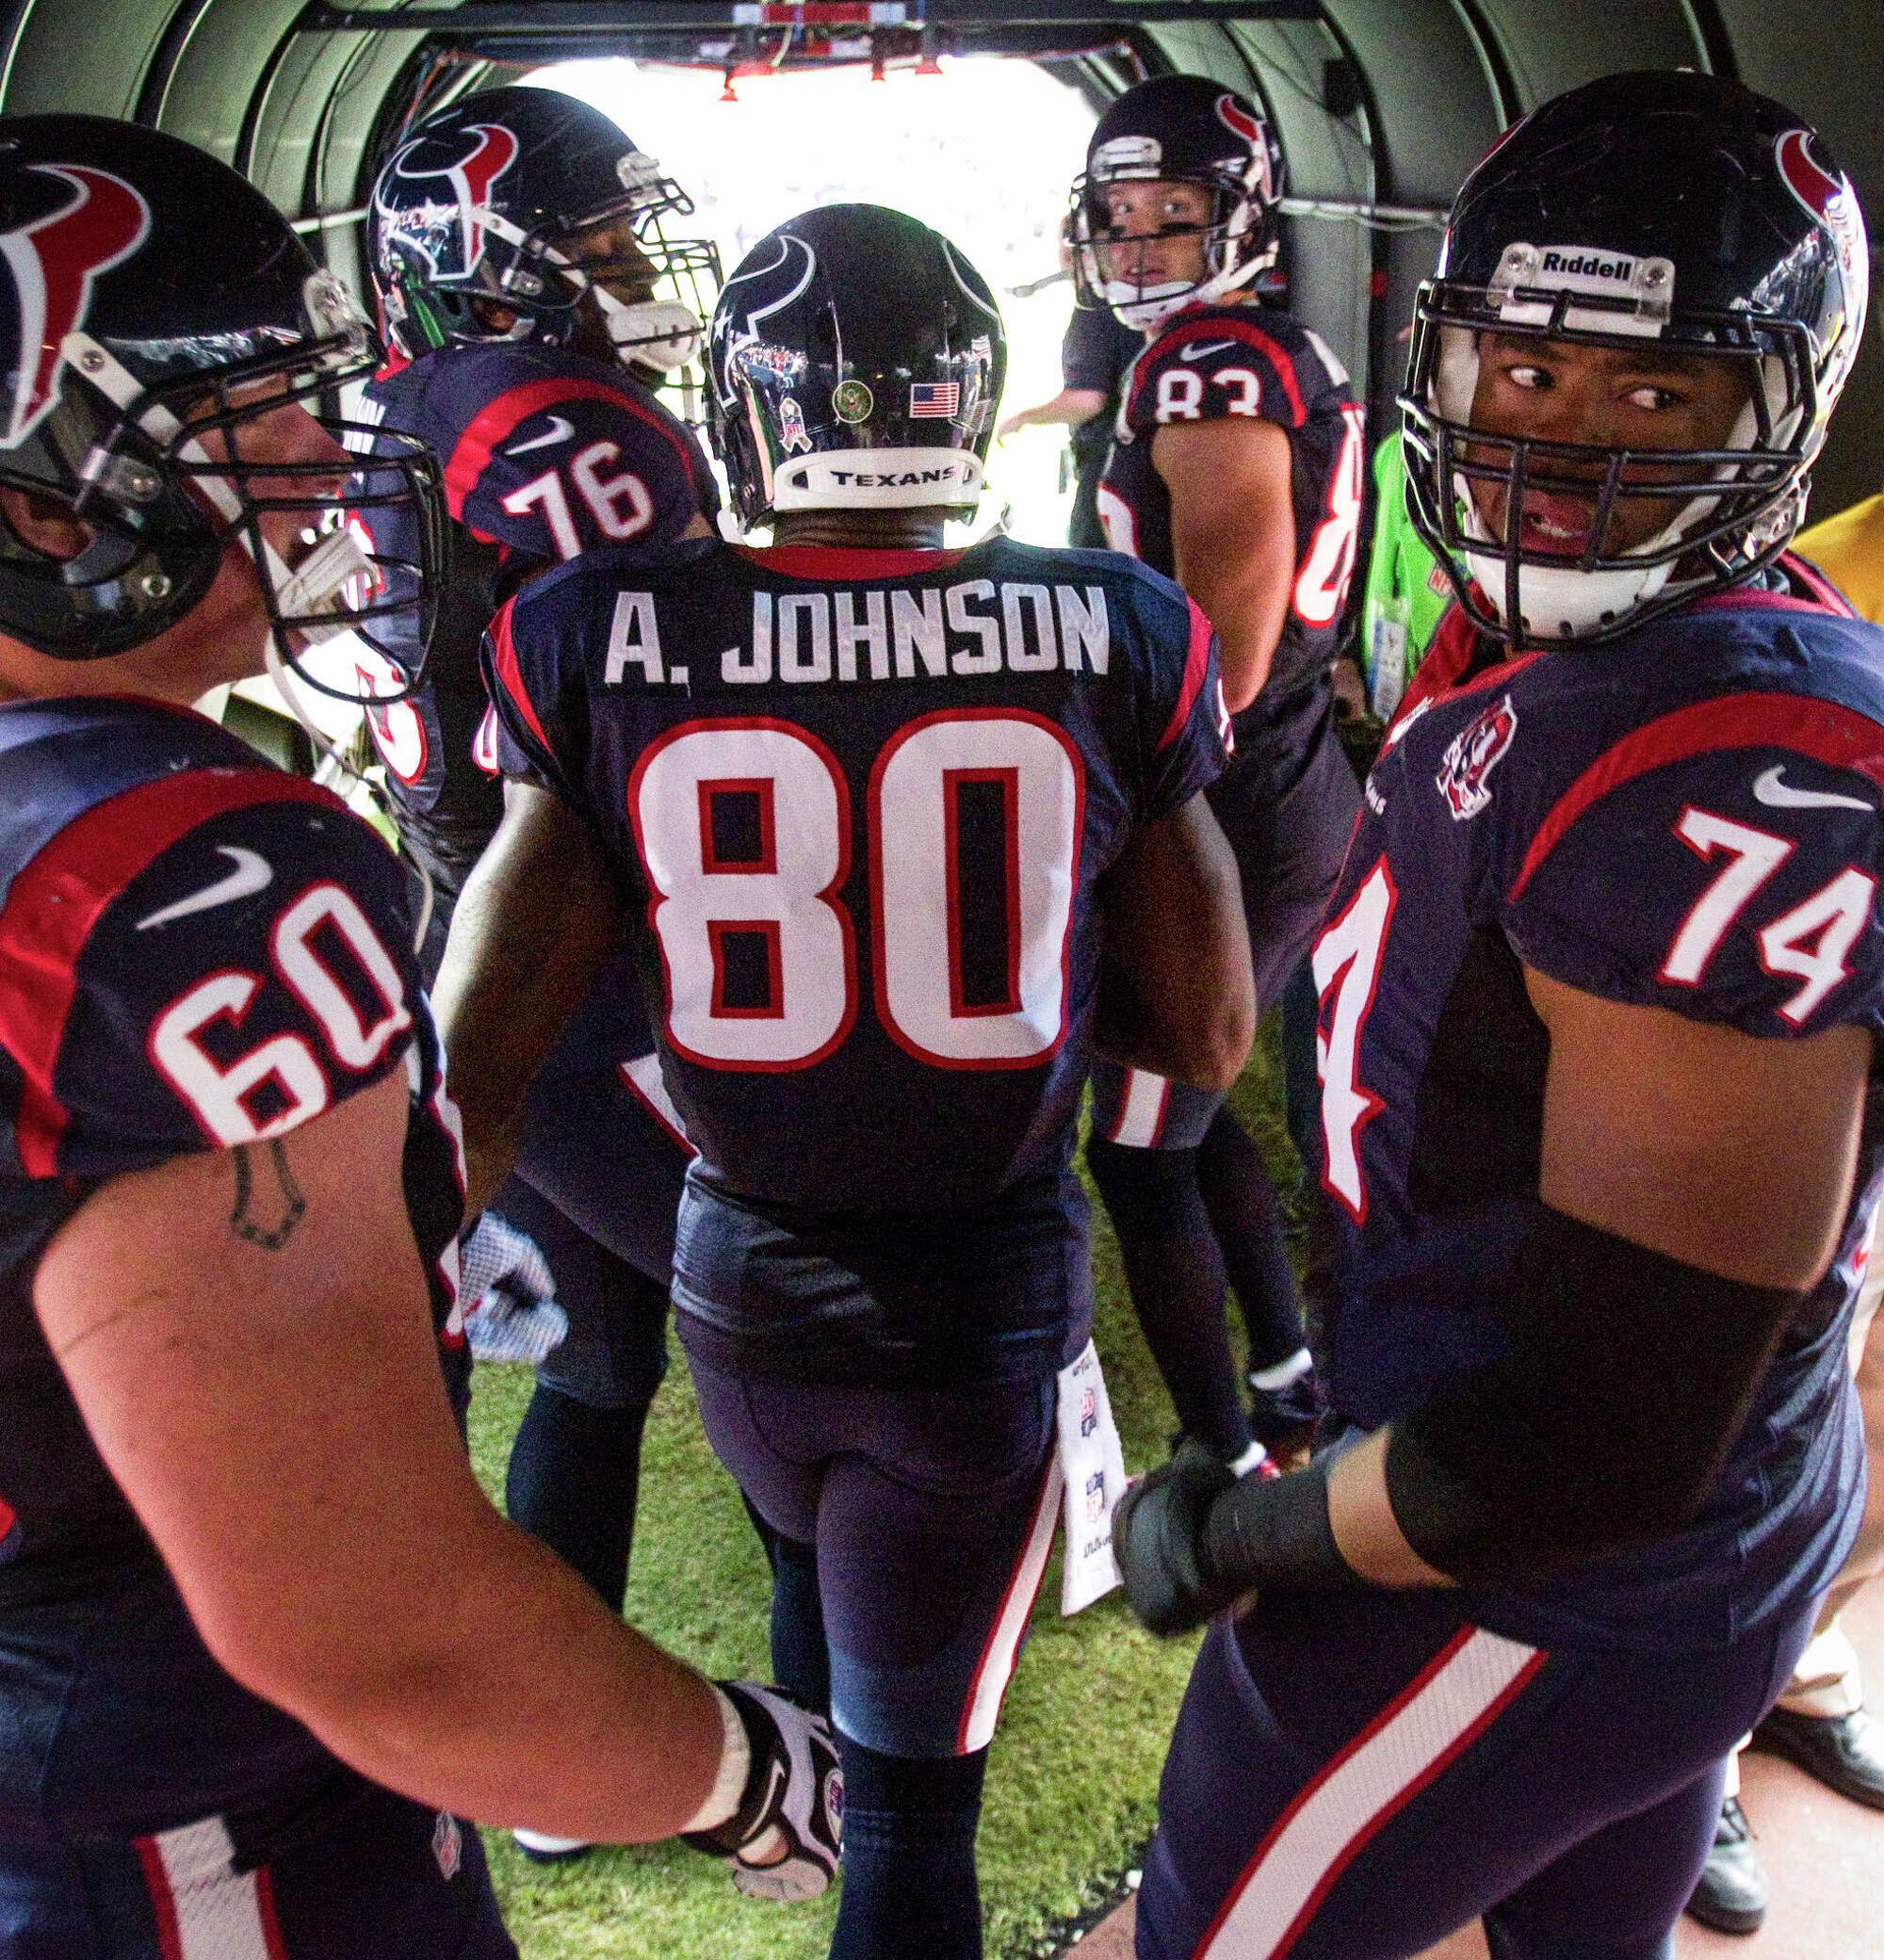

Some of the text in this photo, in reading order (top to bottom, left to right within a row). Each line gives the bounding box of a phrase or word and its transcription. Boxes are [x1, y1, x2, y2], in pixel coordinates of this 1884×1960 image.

[1542, 252, 1632, 281] Riddell
[499, 439, 655, 562] 76
[829, 465, 956, 487] TEXANS
[604, 578, 1111, 684] A. JOHNSON
[626, 706, 1088, 1074] 80
[1655, 802, 1879, 1029] 74
[146, 878, 412, 1149] 60
